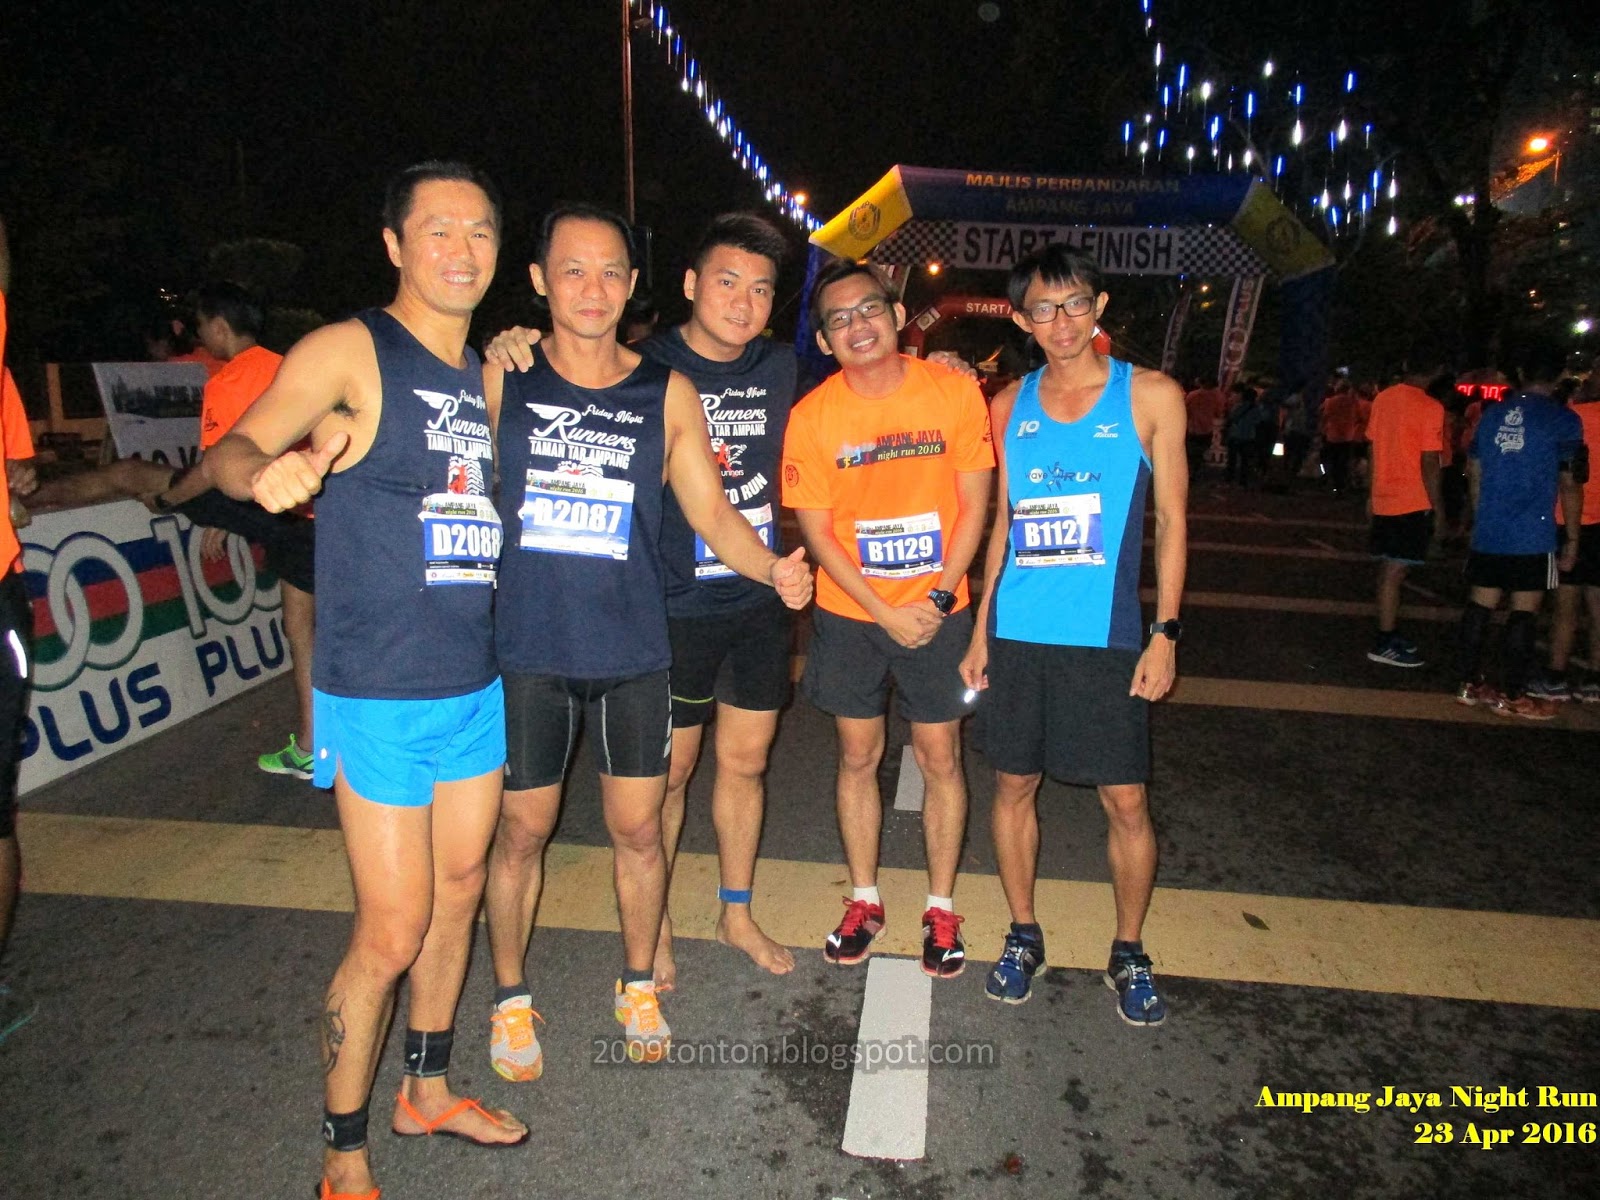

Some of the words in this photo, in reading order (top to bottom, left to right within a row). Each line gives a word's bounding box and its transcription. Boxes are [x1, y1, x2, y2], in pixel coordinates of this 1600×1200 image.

[966, 173, 1031, 189] MAJLIS
[1036, 177, 1179, 192] PERBANDARAN
[1006, 198, 1087, 213] AMPANG
[1093, 200, 1134, 215] JAYA
[964, 227, 1057, 264] START
[1081, 231, 1173, 269] FINISH
[966, 302, 1005, 314] START
[582, 404, 613, 419] Friday
[614, 410, 644, 424] Night
[528, 404, 637, 453] Runners
[715, 424, 731, 436] TAR
[732, 423, 766, 437] AMPANG
[877, 431, 914, 448] AMPANG
[916, 429, 944, 444] JAYA
[1017, 420, 1040, 436] 10
[530, 440, 566, 458] TAMAN
[568, 445, 586, 461] TAR
[585, 448, 631, 470] AMPANG
[878, 449, 898, 461] night
[901, 448, 916, 456] run
[918, 443, 941, 455] 2016
[740, 472, 768, 501] RUN
[432, 523, 500, 558] D2088
[1024, 519, 1089, 547] B1127
[868, 535, 933, 562] B1129
[195, 617, 286, 698] PLU
